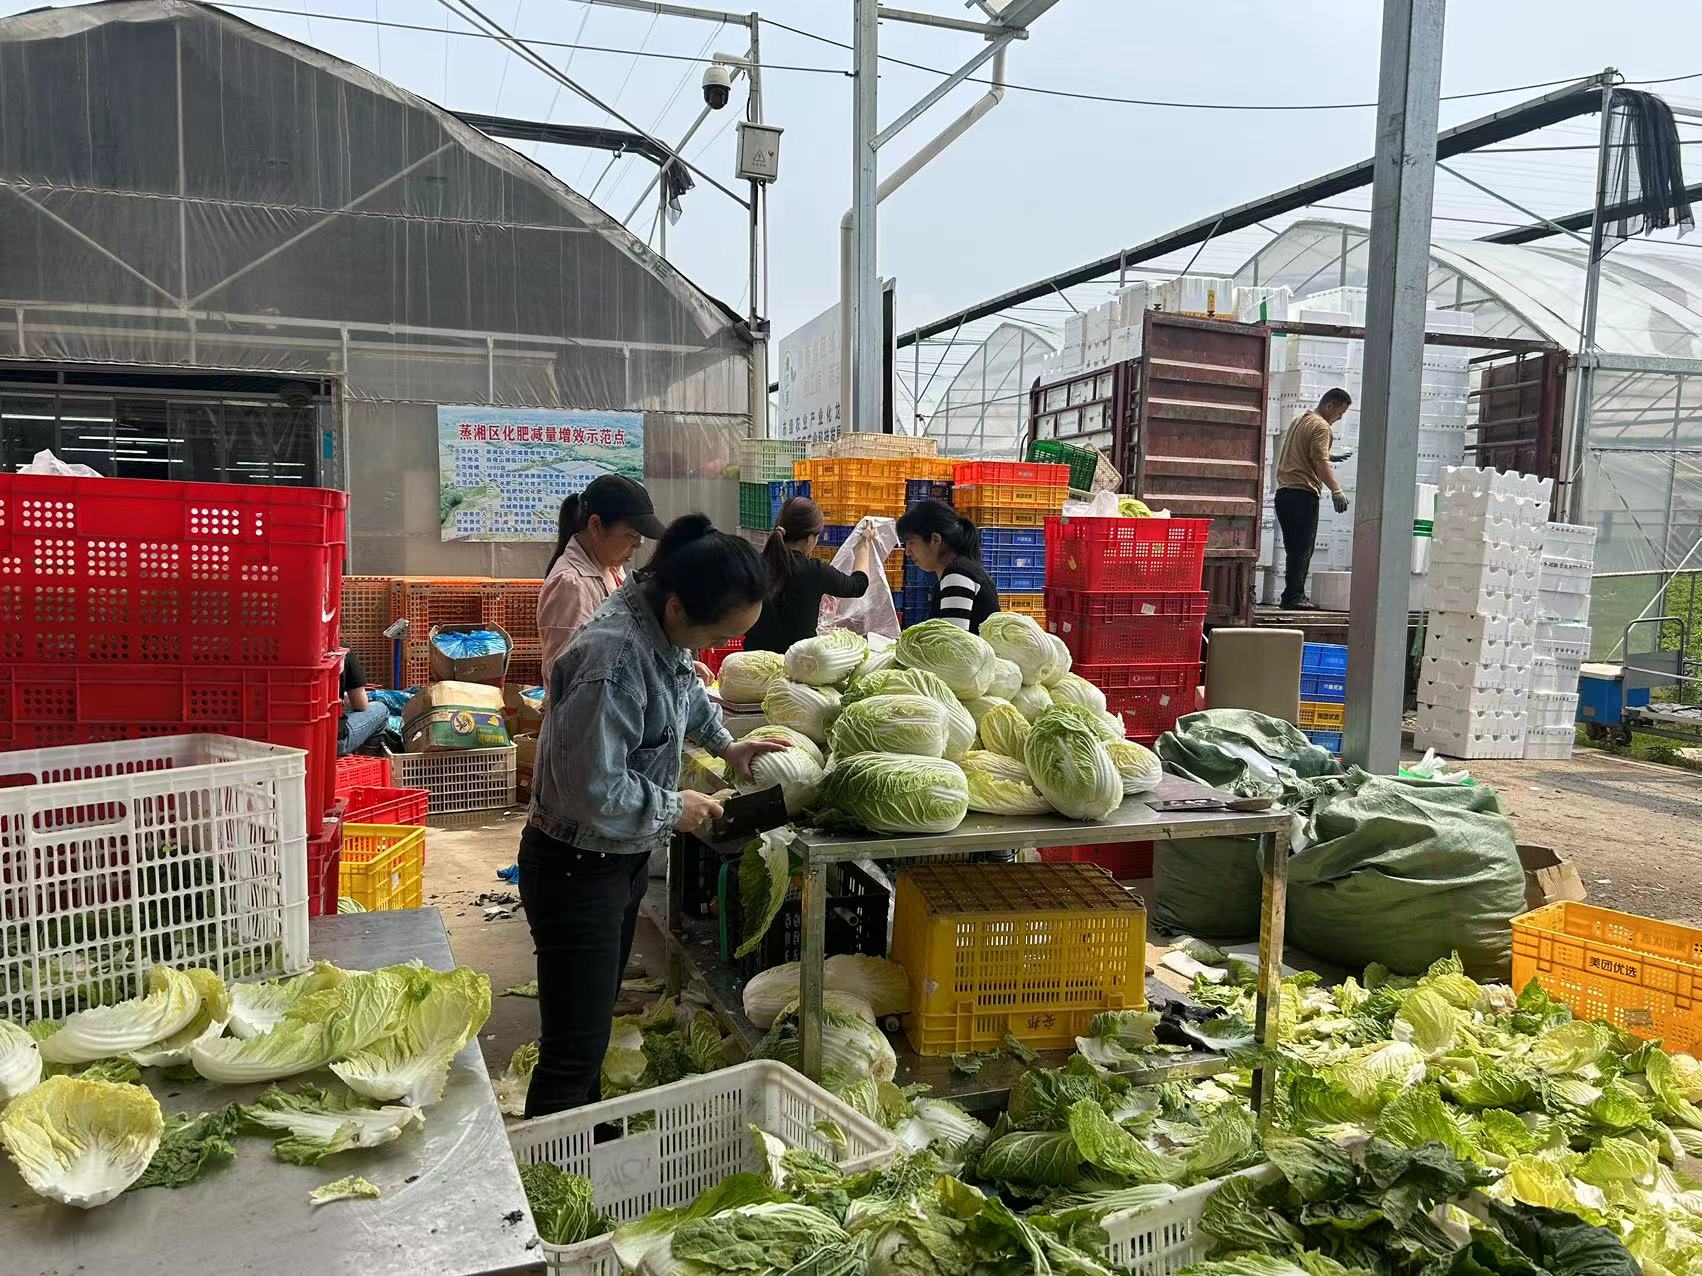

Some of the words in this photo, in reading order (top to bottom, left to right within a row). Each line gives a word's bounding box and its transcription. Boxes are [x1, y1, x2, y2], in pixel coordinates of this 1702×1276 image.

[459, 423, 626, 445] 蒸湘区化肥减量增效示范点
[1589, 956, 1638, 978] 美团优选
